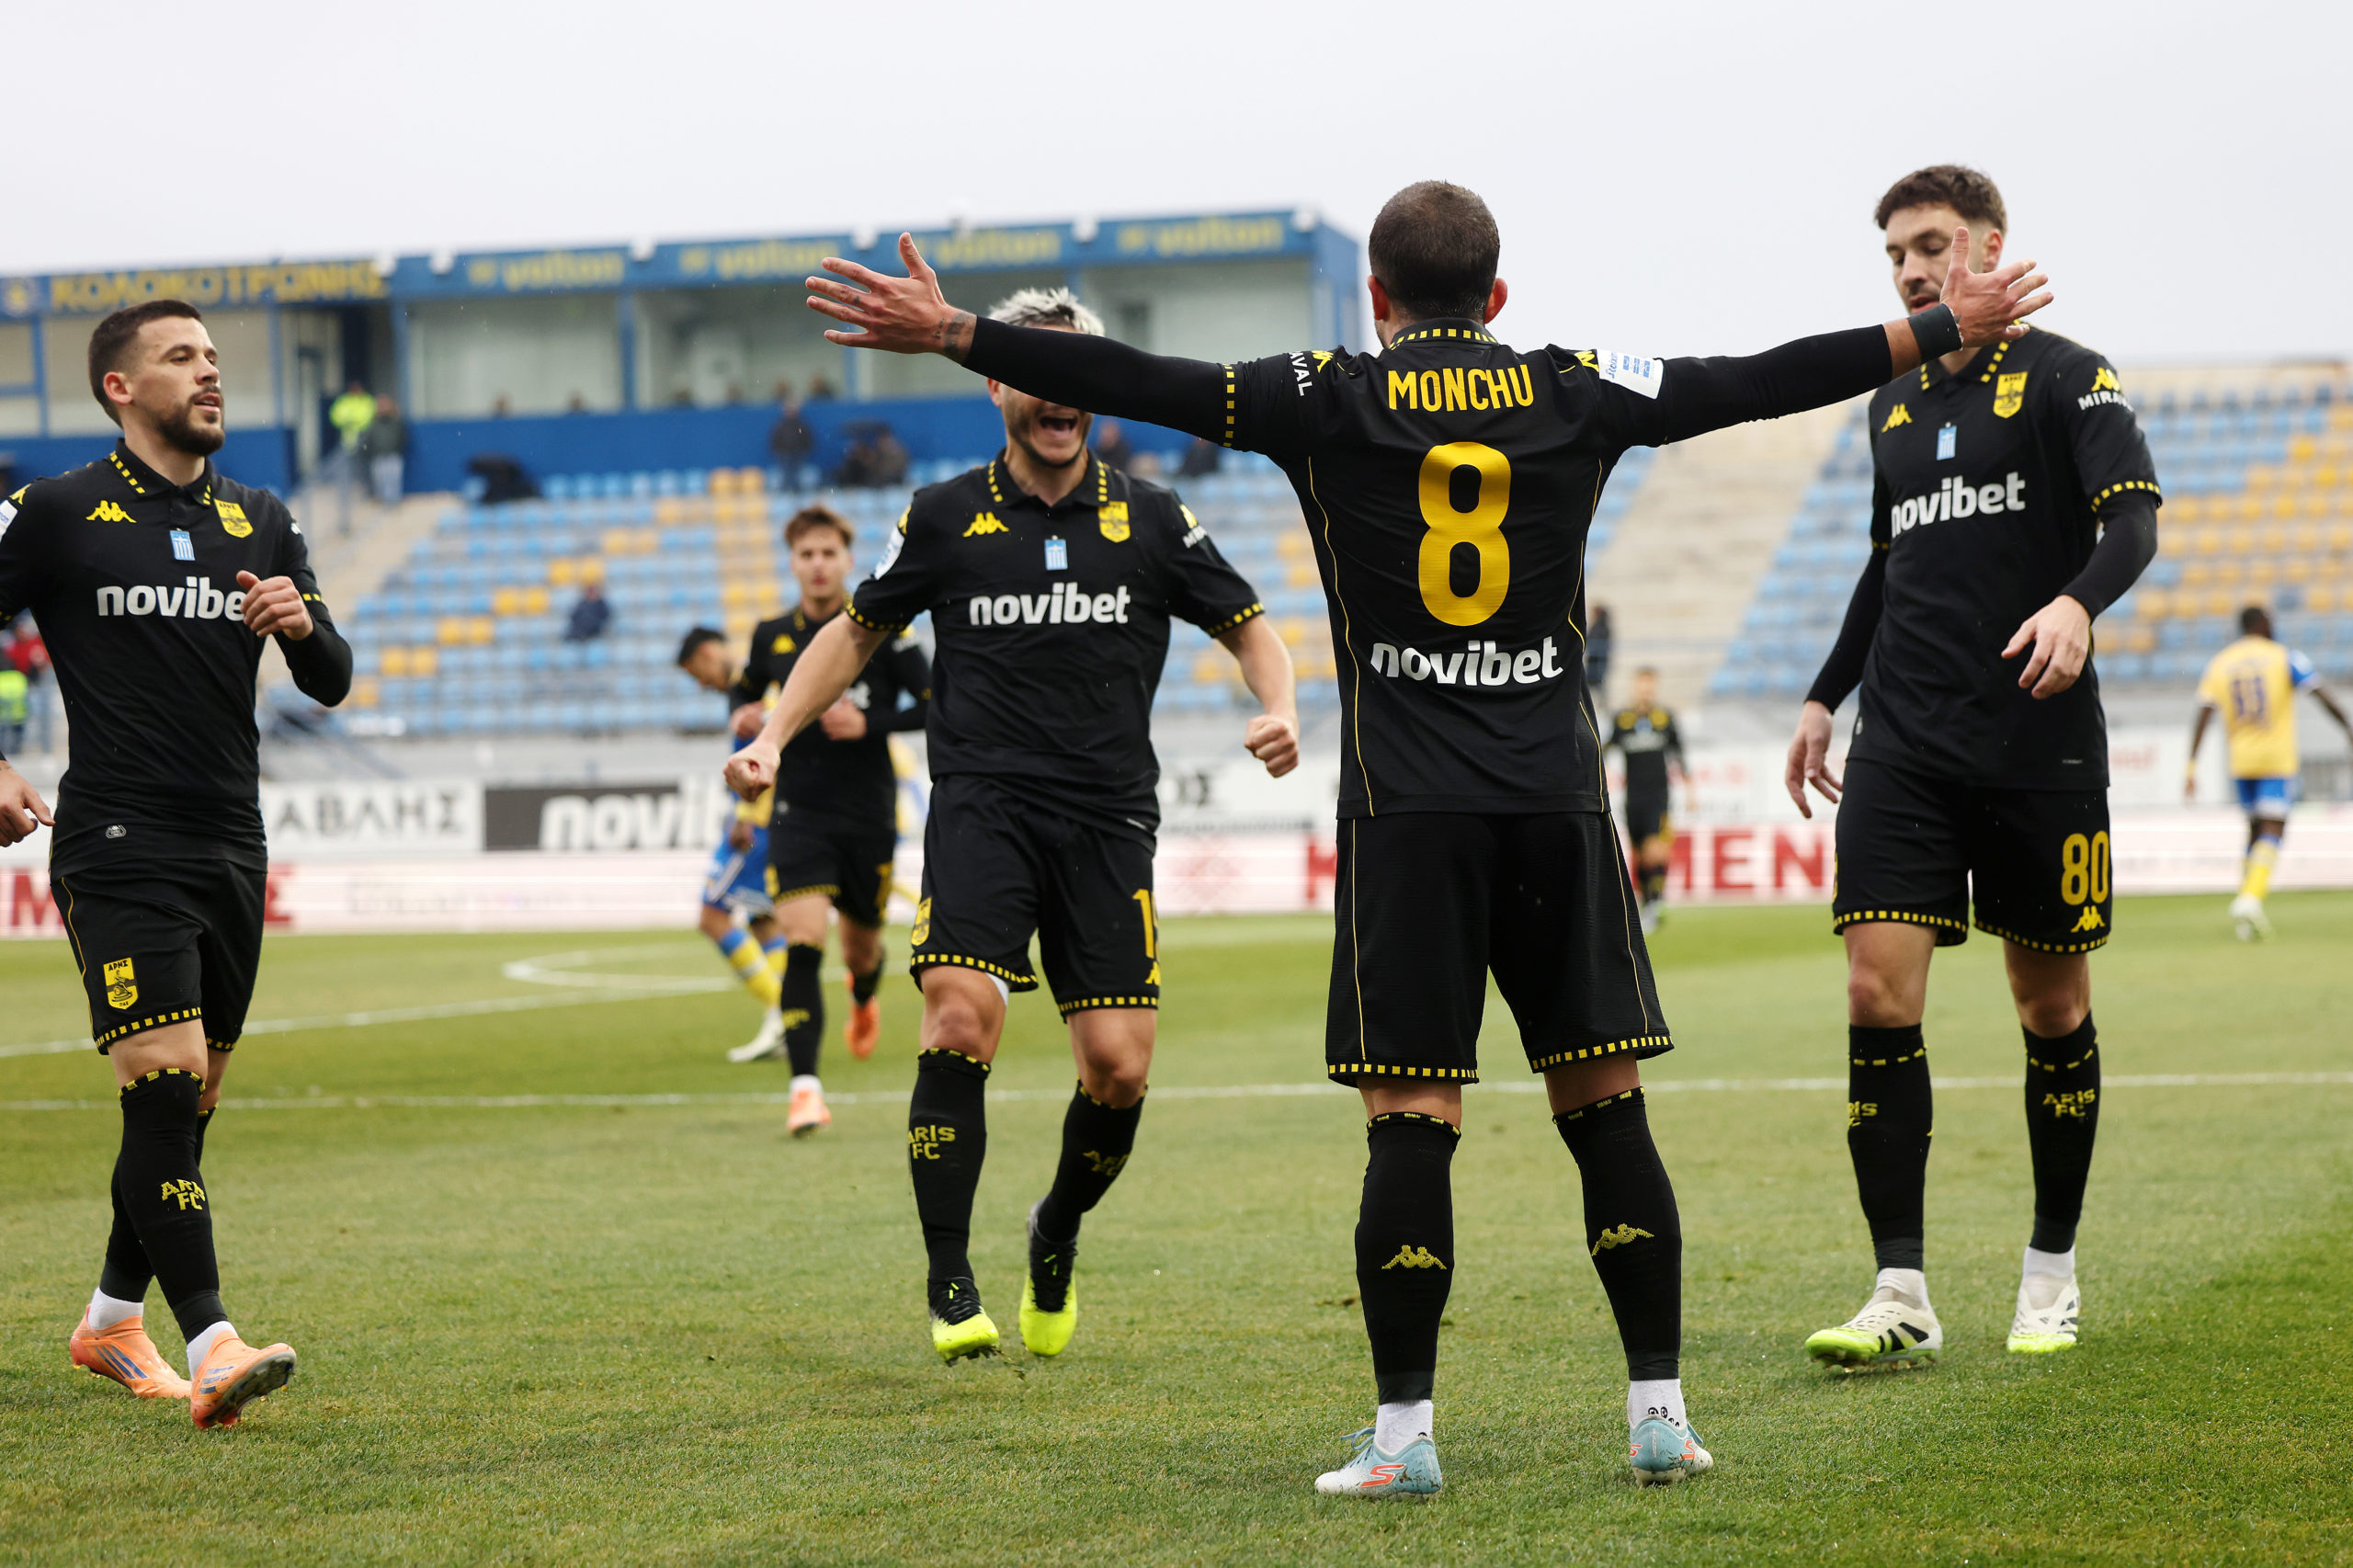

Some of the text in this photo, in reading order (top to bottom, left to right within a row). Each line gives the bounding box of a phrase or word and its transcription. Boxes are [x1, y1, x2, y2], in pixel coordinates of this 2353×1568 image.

[1388, 364, 1534, 412] MONCHU
[1891, 471, 2026, 540] novibet
[1418, 441, 1511, 627] 8
[97, 576, 246, 621] novibe
[970, 582, 1131, 626] novibet
[1370, 636, 1563, 687] novibet
[2061, 830, 2109, 905] 80
[1131, 889, 1159, 960] 1
[1847, 1101, 1879, 1117] RIS
[2043, 1088, 2096, 1105] ARIS
[2055, 1104, 2086, 1119] FC
[913, 1142, 940, 1160] FC
[177, 1191, 203, 1210] FC
